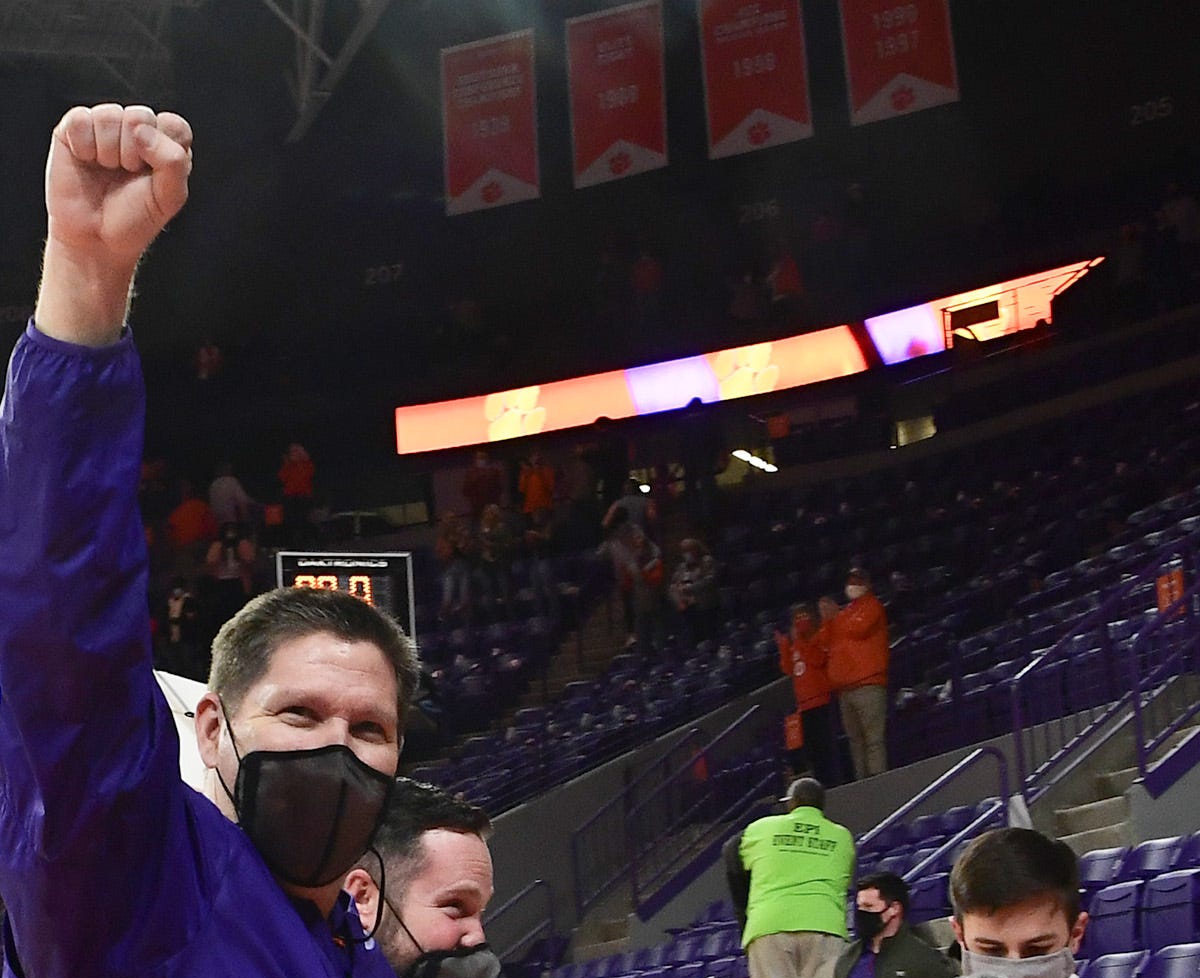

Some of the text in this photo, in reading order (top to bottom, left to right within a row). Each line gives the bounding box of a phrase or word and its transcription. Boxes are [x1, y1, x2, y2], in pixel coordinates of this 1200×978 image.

[1128, 94, 1172, 126] 205
[737, 198, 779, 224] 206
[365, 262, 402, 286] 207
[794, 823, 820, 834] EPI
